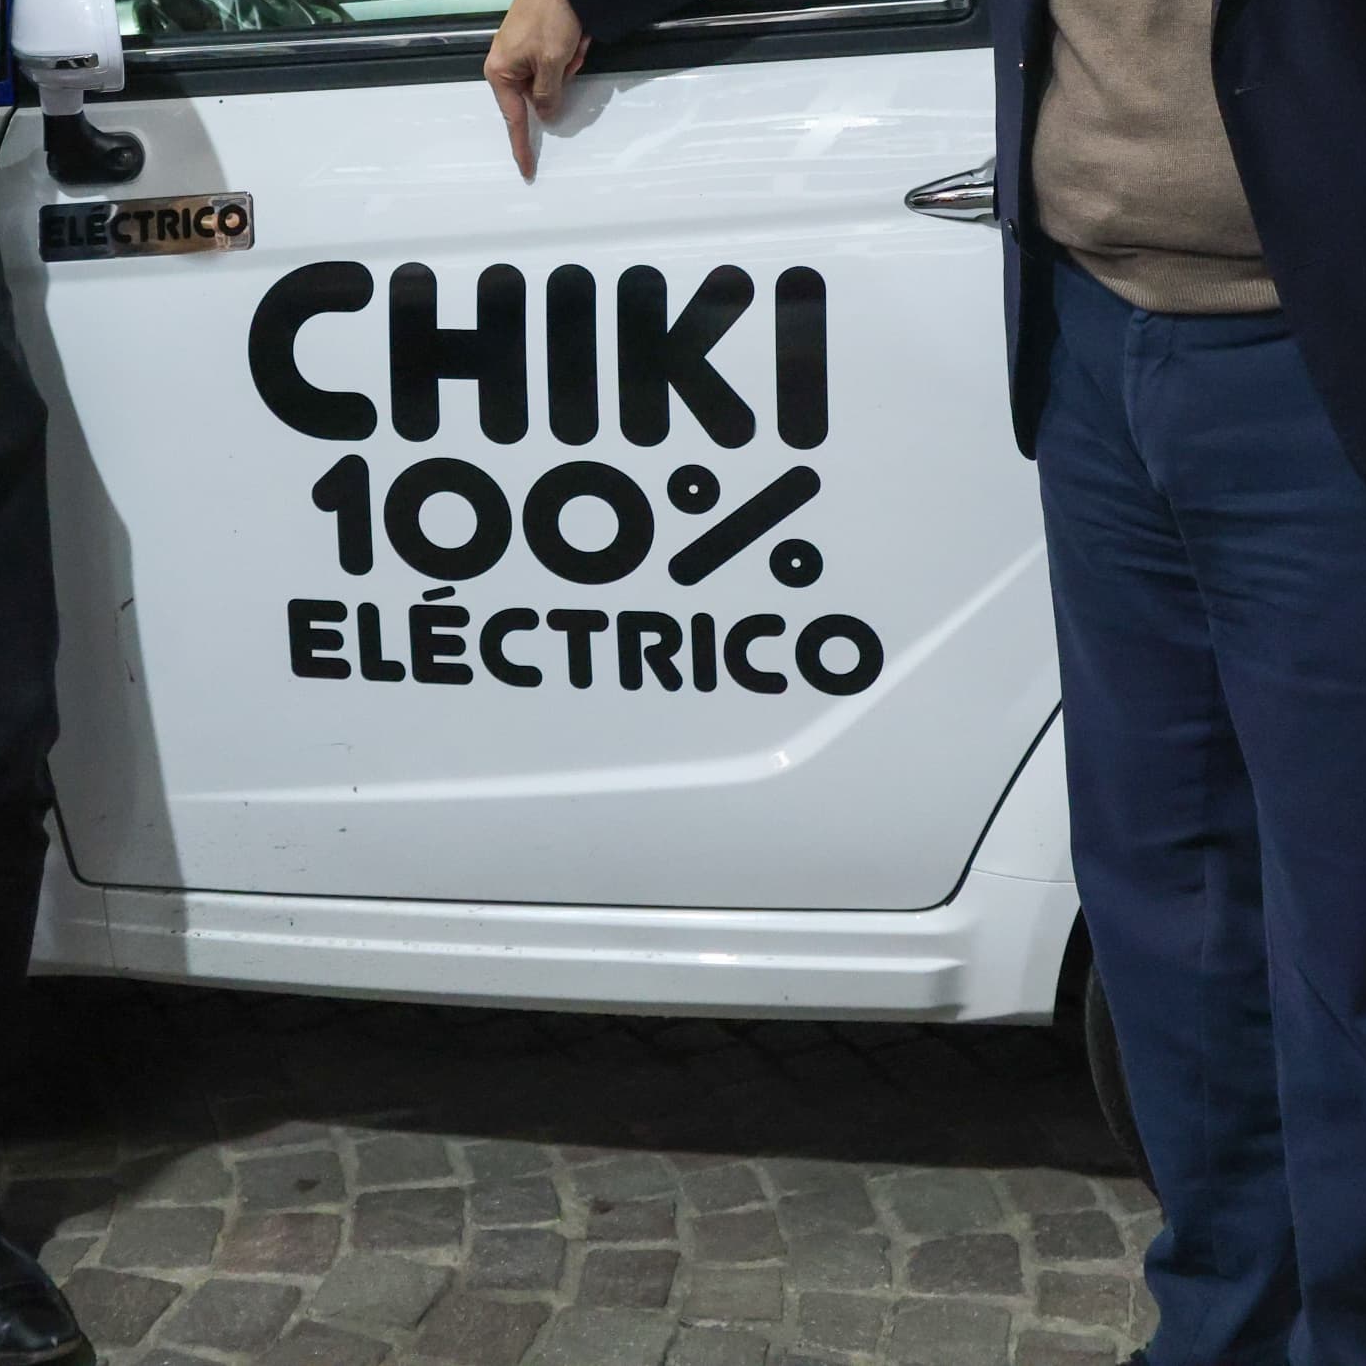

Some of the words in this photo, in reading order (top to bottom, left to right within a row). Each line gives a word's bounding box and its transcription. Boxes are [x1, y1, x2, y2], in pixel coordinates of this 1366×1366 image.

[46, 203, 249, 247] ELÉCTRICO
[248, 260, 829, 450] CHIKI
[312, 454, 824, 588] 100%
[287, 586, 884, 696] ELÉCTRICO
